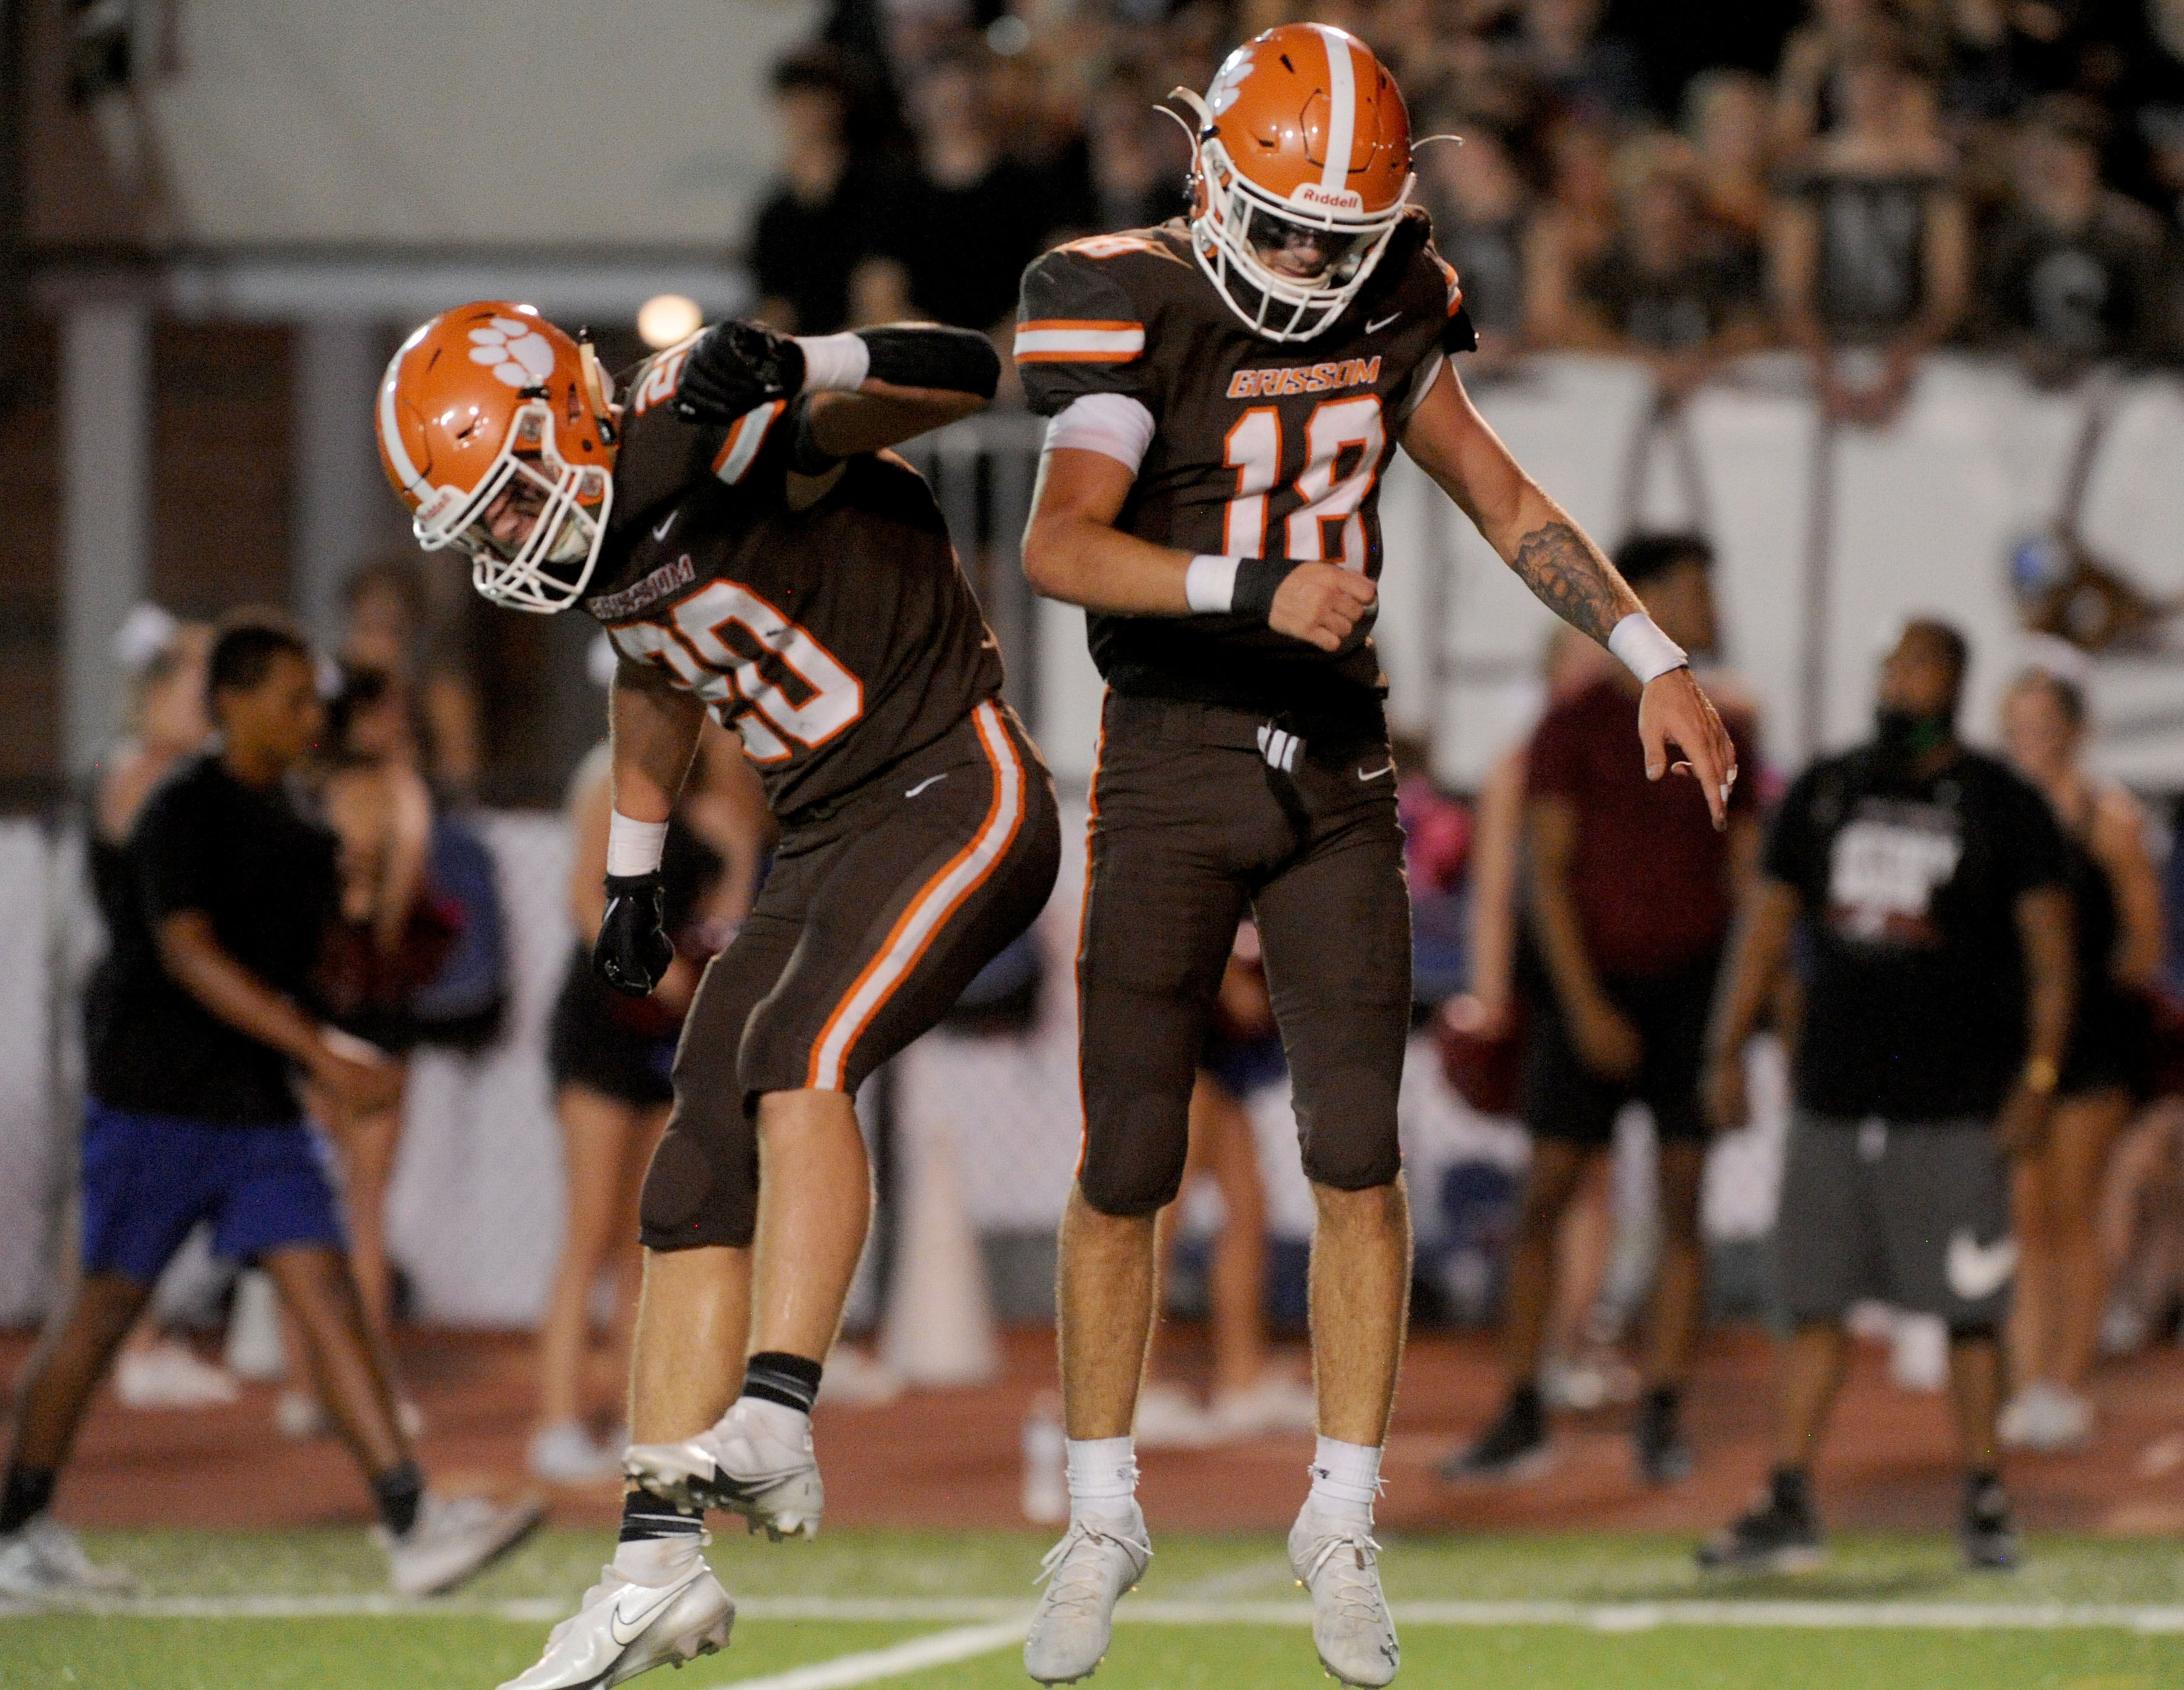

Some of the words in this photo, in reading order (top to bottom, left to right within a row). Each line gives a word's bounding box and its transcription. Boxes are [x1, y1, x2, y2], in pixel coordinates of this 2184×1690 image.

[1303, 189, 1358, 208] Riddell
[1227, 356, 1382, 398] GRISSOM
[1223, 392, 1387, 575] 18
[607, 579, 863, 763] 20
